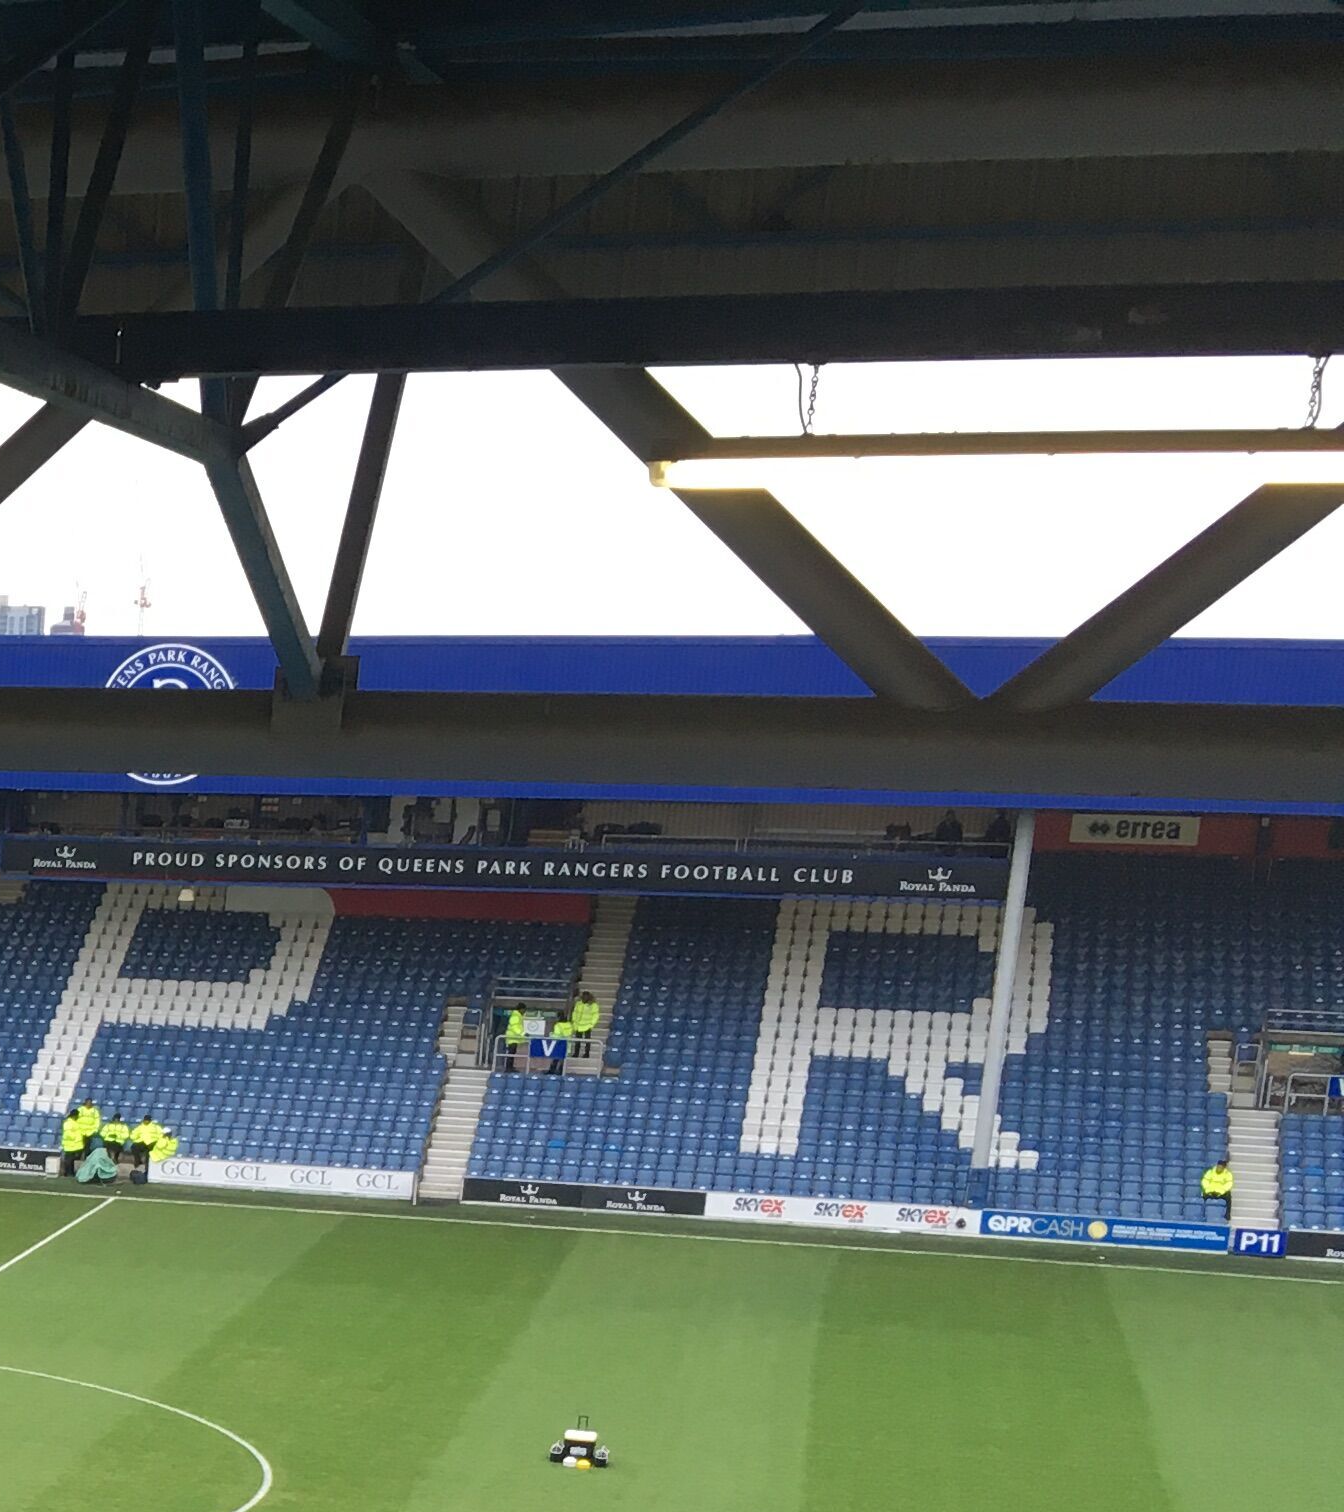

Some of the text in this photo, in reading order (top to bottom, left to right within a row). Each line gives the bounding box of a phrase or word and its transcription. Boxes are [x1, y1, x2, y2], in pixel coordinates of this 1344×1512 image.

[148, 650, 188, 665] PARK
[1115, 818, 1180, 840] errea
[33, 858, 96, 869] ROYAL PANDA
[133, 852, 854, 884] PROUD SPONSORS OF QUEENS PARK RANGERS FOOTBALL CLUB
[900, 880, 976, 893] ROYAL PANDA
[20, 883, 335, 1114] P
[740, 899, 1055, 1172] R
[541, 1039, 557, 1057] V
[161, 1159, 202, 1177] GCL
[225, 1164, 266, 1182] GCL
[290, 1168, 332, 1186] GCL
[356, 1173, 399, 1190] GCL
[499, 1193, 557, 1205] ROYAL PANDA
[606, 1200, 665, 1212] ROYAL PANDA
[1239, 1231, 1279, 1254] P11
